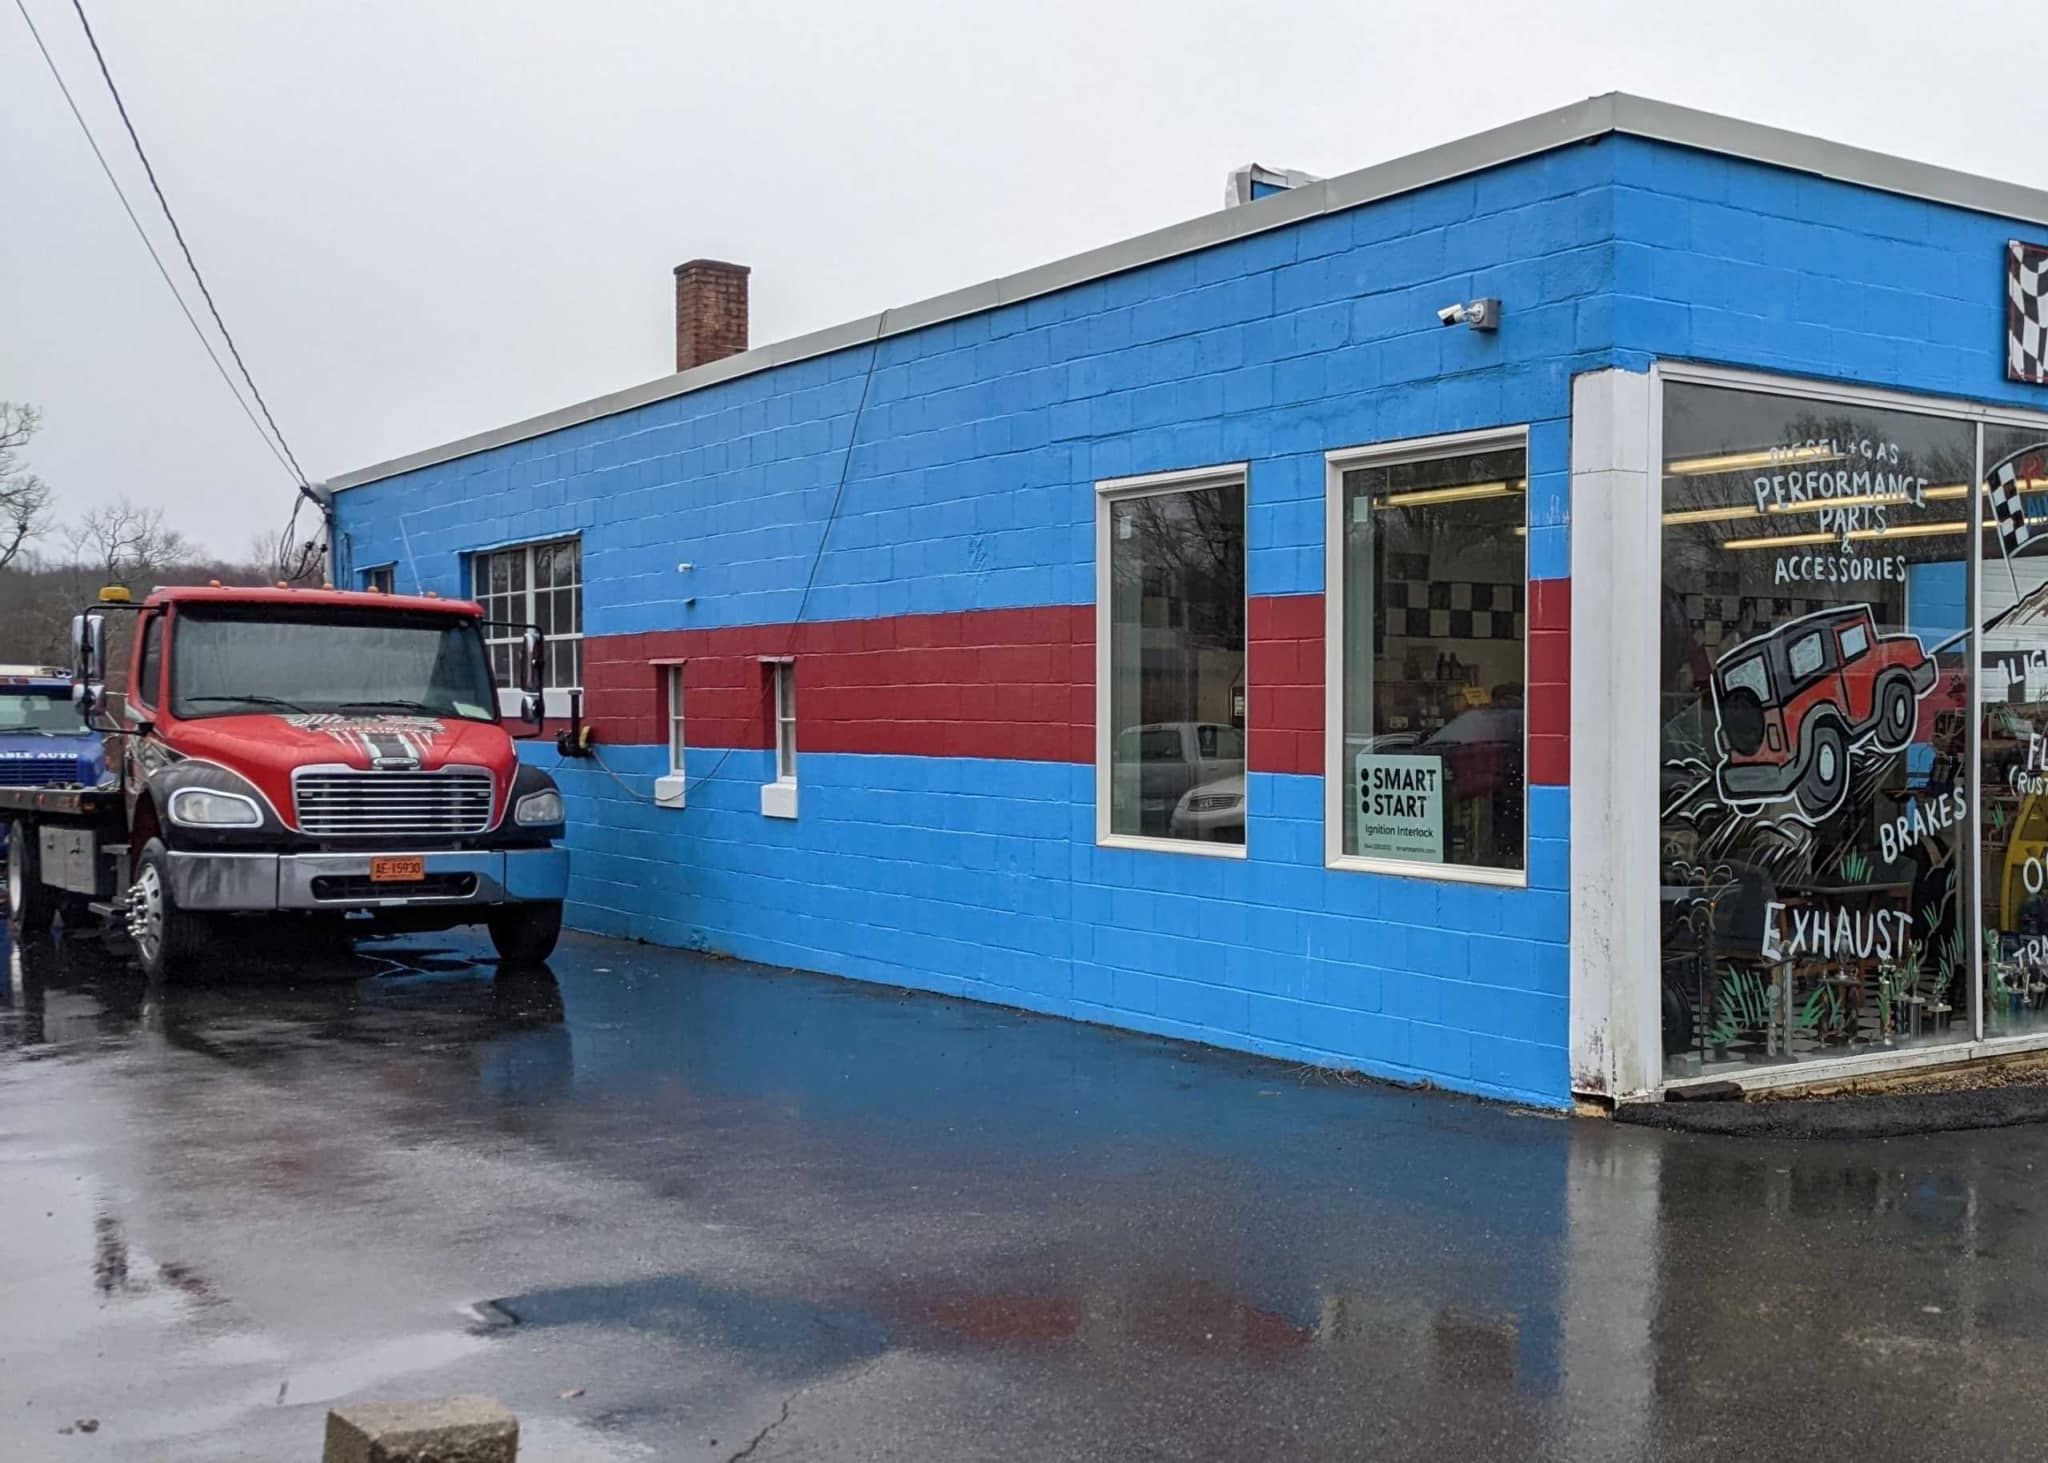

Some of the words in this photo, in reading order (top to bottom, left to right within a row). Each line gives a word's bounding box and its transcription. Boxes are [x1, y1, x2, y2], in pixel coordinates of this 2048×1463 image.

[1753, 470, 1929, 513] PERFORMANCE
[1819, 504, 1888, 534] PARTS
[1840, 534, 1854, 554] &
[1774, 555, 1907, 585] ACCESSORIES
[1998, 650, 2048, 685] ALIG
[37, 751, 79, 760] AUTO
[1373, 768, 1437, 792] SMART
[1374, 793, 1427, 818] START
[1365, 825, 1395, 837] Ignition
[1397, 825, 1434, 838] Interlock
[1879, 786, 1968, 864] BRAKES
[1761, 901, 1914, 961] EXHAUST
